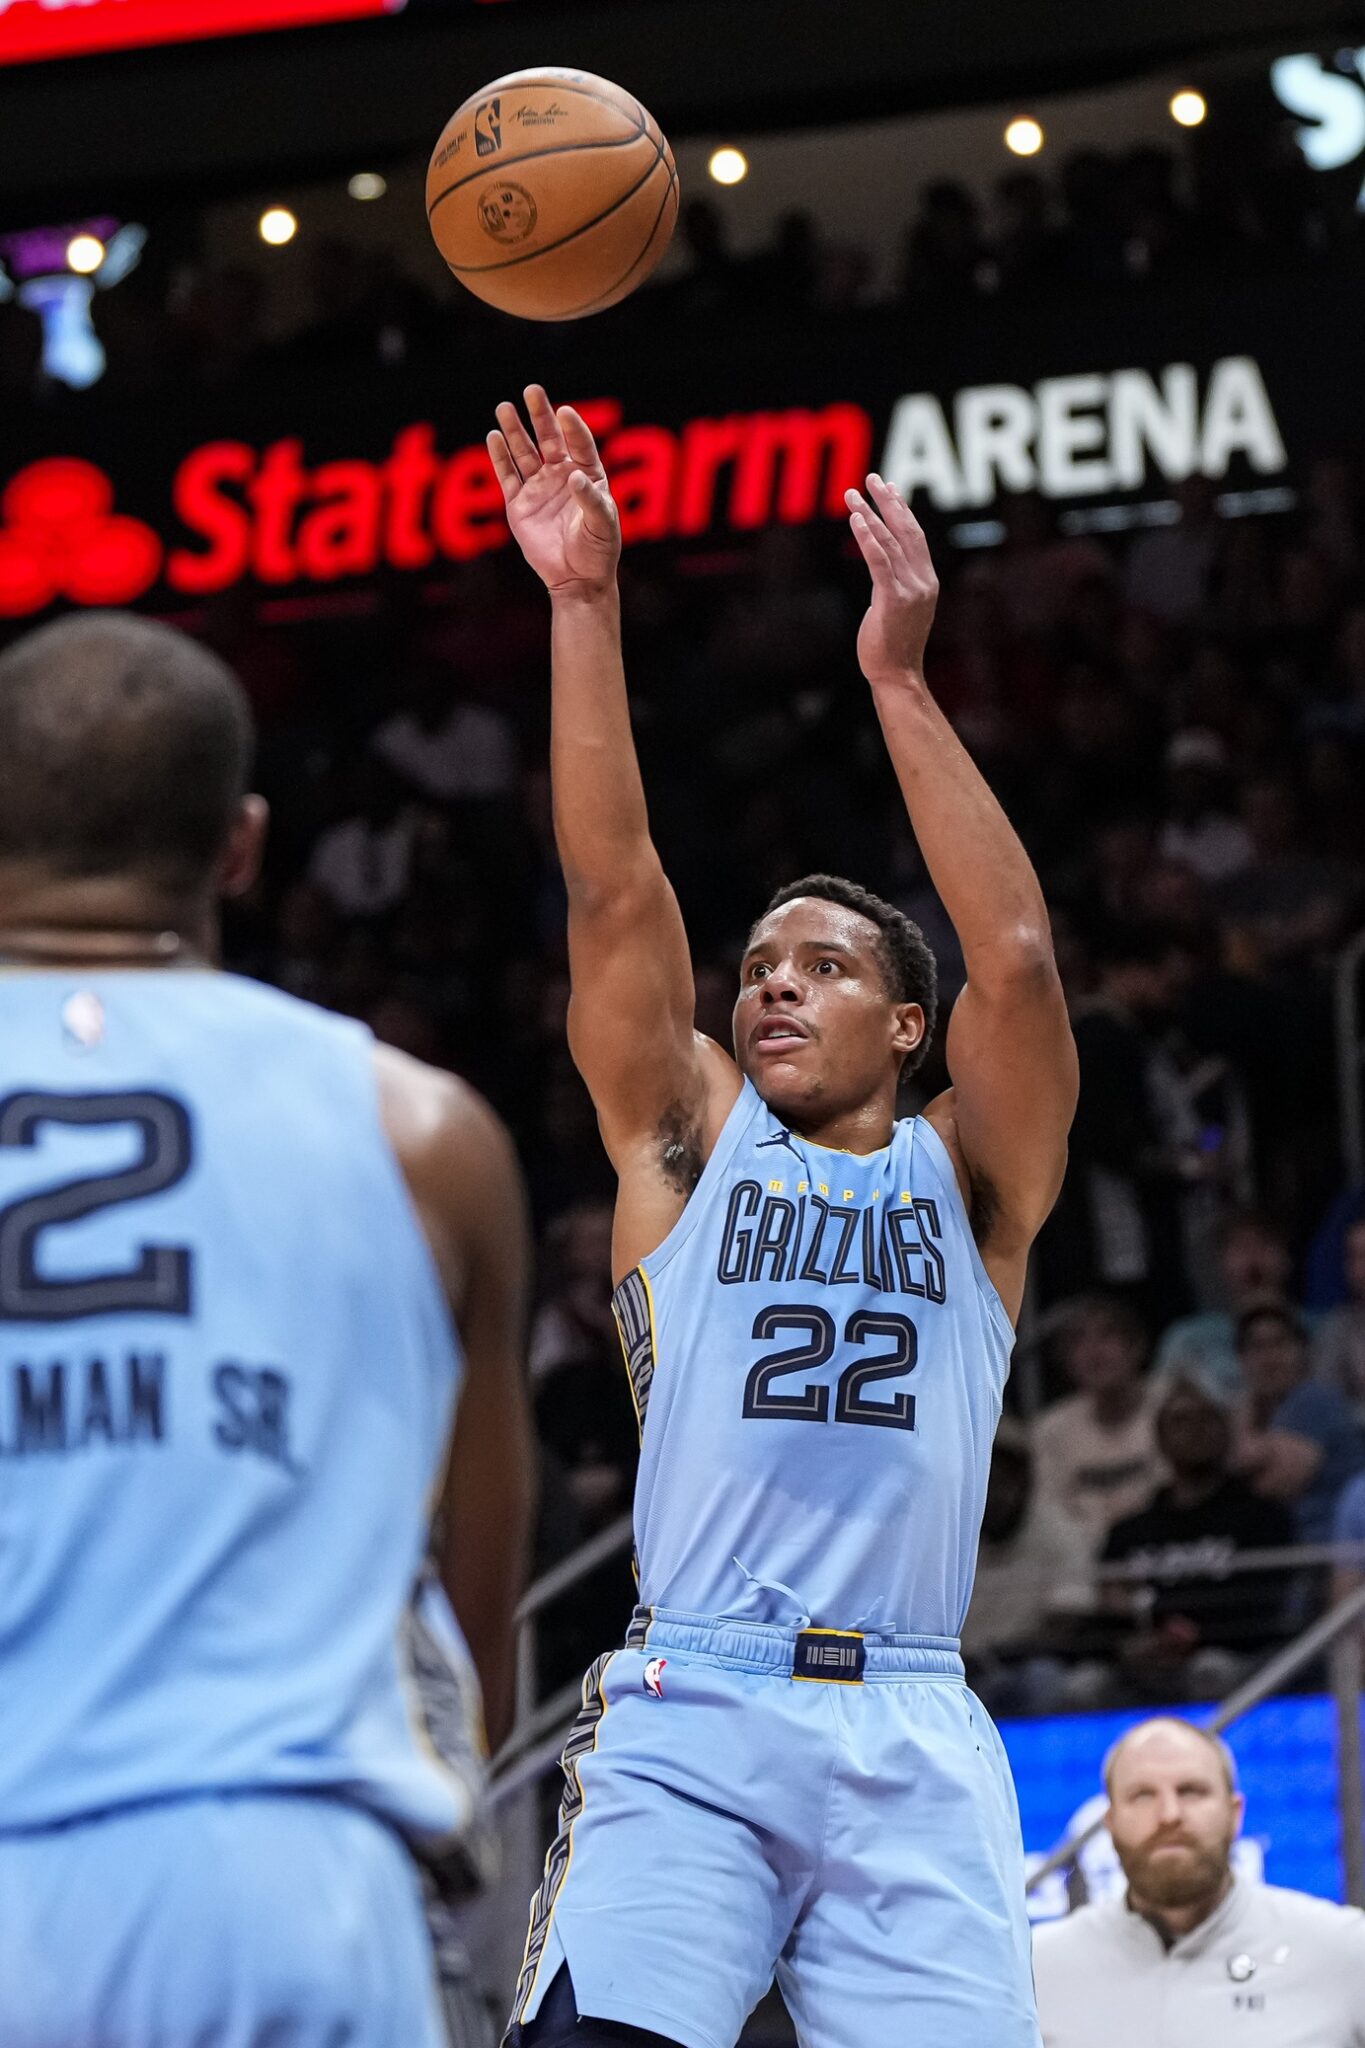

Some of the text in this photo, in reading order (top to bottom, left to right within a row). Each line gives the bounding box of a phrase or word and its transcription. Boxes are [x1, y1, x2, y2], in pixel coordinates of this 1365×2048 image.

[881, 355, 1289, 512] ARENA
[0, 1088, 193, 1322] 2
[717, 1180, 946, 1305] GRIZZLIES
[0, 1352, 302, 1468] MAN SR
[742, 1304, 917, 1431] 22
